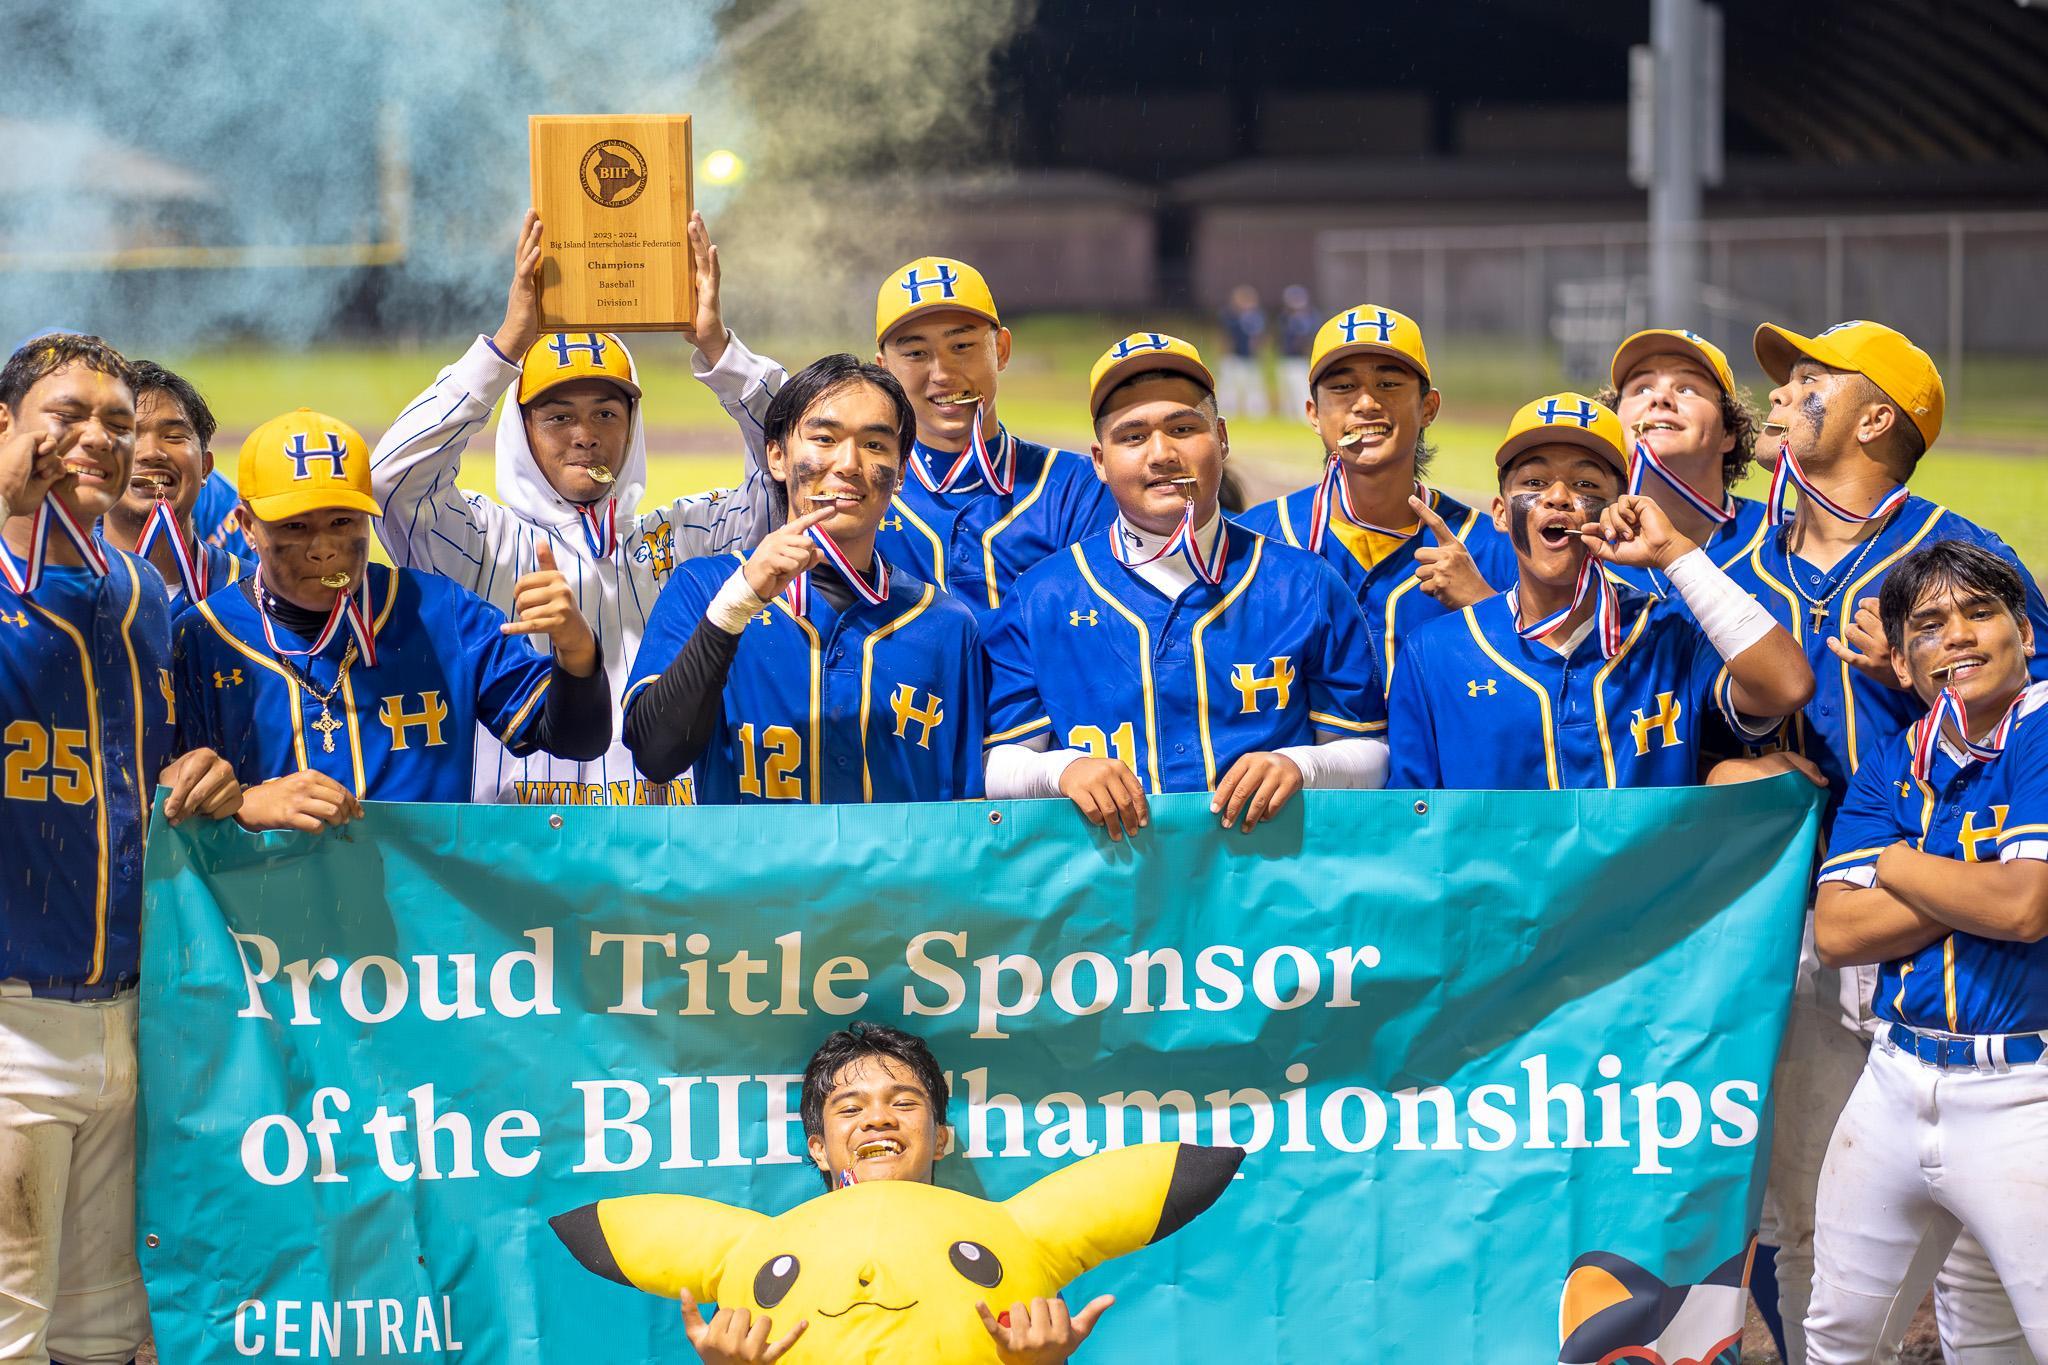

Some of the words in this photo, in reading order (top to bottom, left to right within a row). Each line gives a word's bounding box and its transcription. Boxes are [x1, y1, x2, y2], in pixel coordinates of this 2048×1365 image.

[600, 167, 630, 179] BIIF
[550, 241, 562, 250] Big
[587, 261, 645, 270] Champions
[597, 298, 632, 307] Division
[634, 298, 638, 306] I
[599, 280, 635, 289] Baseball
[284, 431, 347, 480] H
[4, 720, 95, 805] 25
[738, 722, 803, 800] 12
[514, 781, 604, 805] VIKING
[228, 926, 560, 1026] Proud
[590, 930, 869, 1016] Title
[903, 930, 1381, 1040] Sponsor
[240, 1087, 351, 1186] of
[363, 1083, 541, 1182] the
[572, 1074, 807, 1173] BIIF
[943, 1053, 1761, 1180] hampionships
[234, 1295, 463, 1358] CENTRAL
